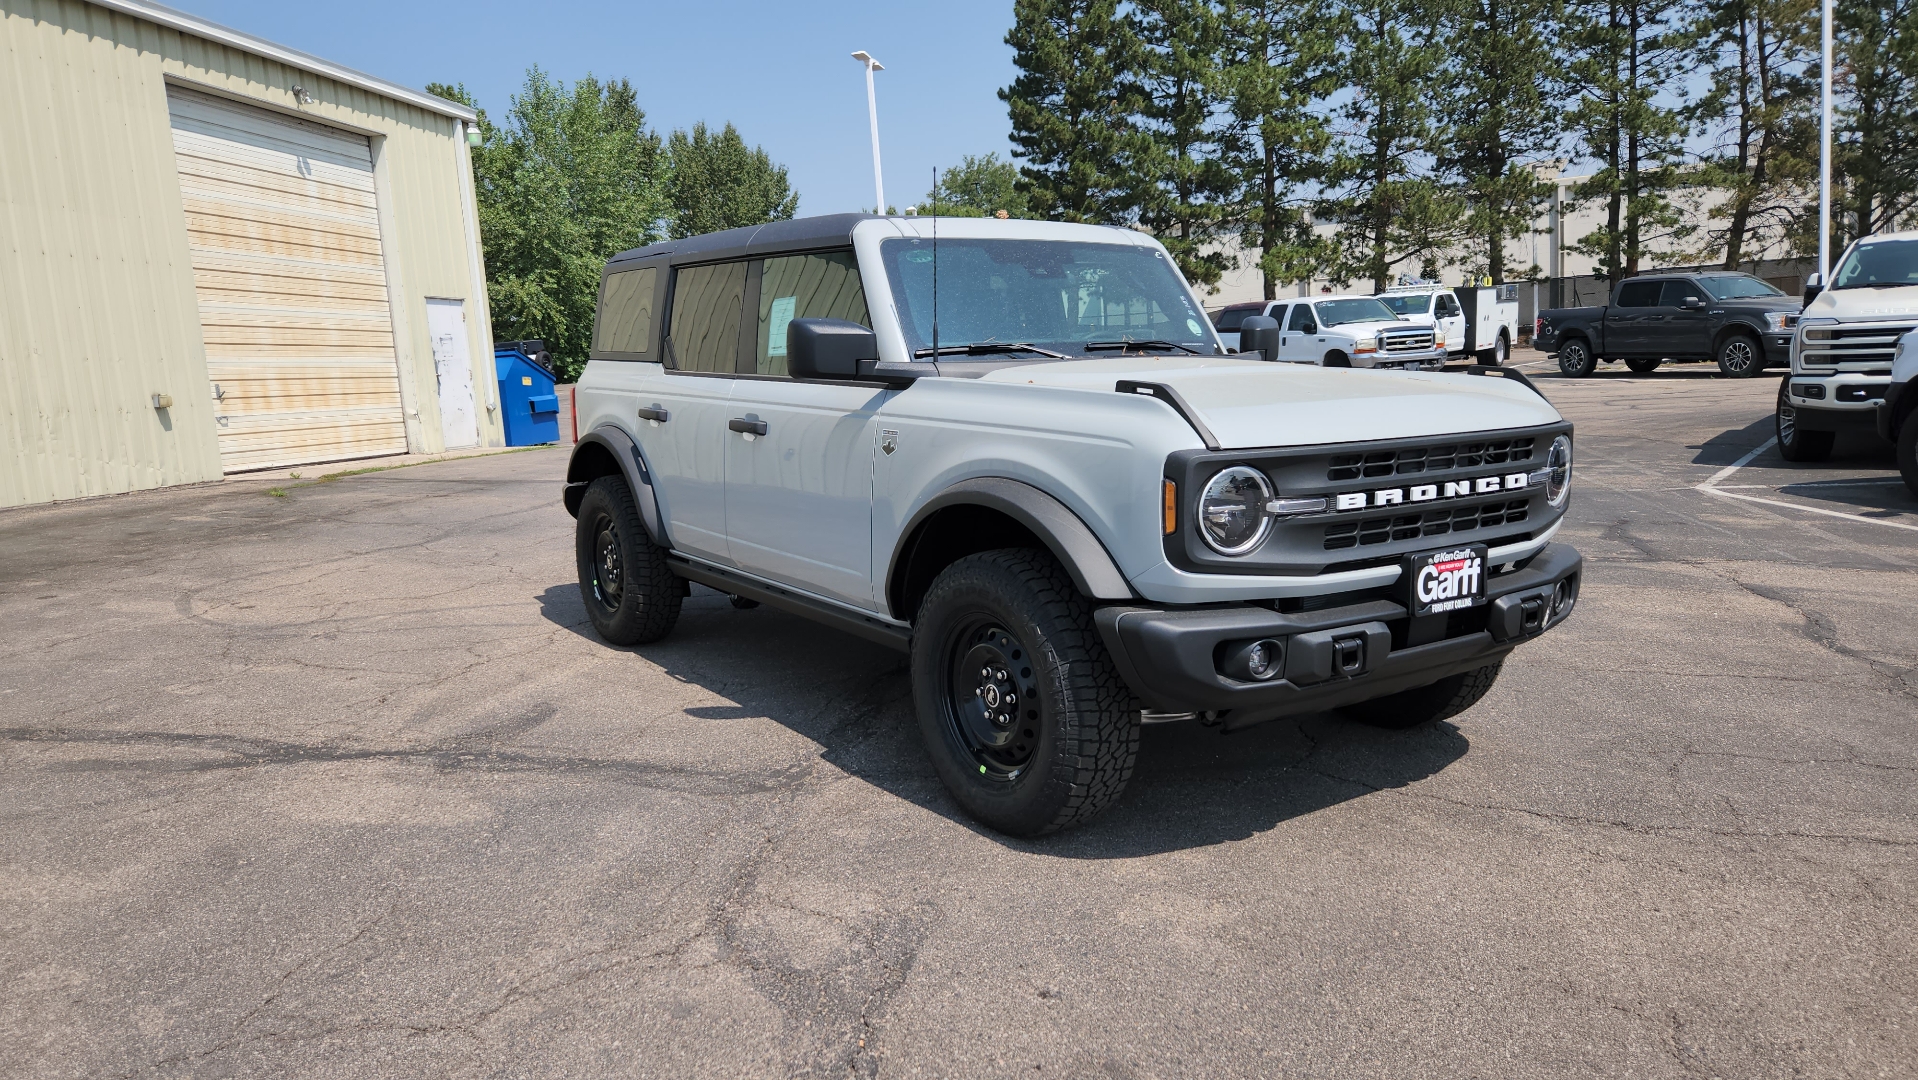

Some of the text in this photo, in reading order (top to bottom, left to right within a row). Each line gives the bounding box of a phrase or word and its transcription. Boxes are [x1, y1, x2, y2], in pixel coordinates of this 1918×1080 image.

[1336, 473, 1528, 510] BRONCO
[1440, 552, 1453, 562] Ken
[1454, 548, 1471, 560] Garff
[1417, 557, 1481, 603] Garff
[1431, 598, 1472, 613] FORD FORT COLLINS
